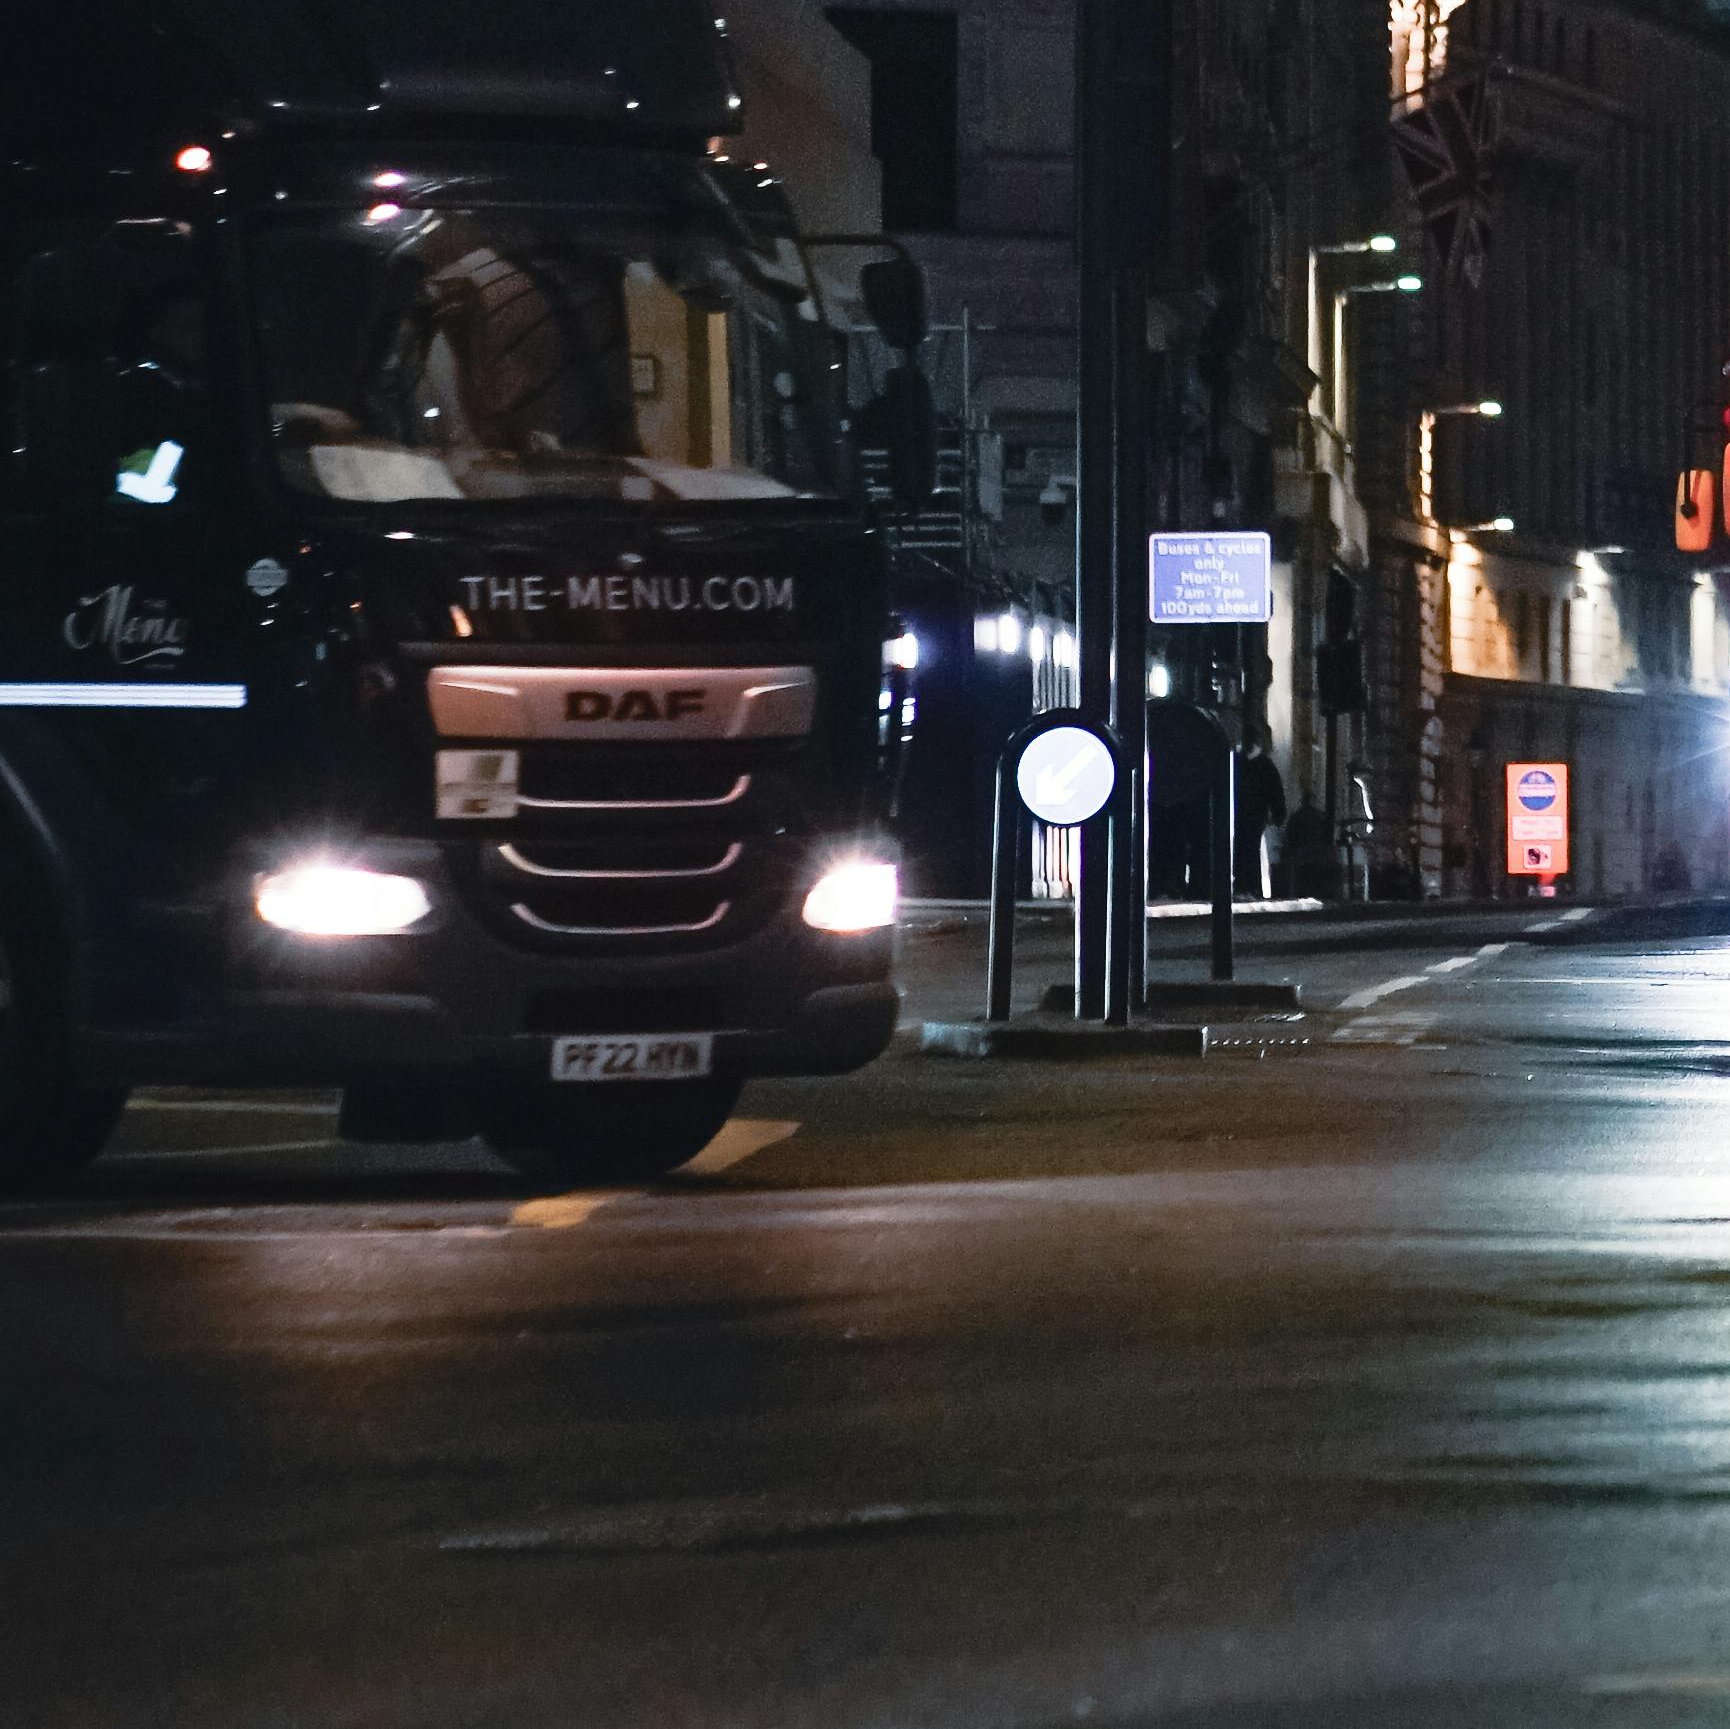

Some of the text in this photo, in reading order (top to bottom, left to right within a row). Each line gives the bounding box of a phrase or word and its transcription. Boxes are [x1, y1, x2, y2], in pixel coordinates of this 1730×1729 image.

[1158, 541, 1200, 555] Buses
[1218, 542, 1261, 557] cycles
[1194, 556, 1224, 572] only
[459, 575, 794, 611] THE-MENU.COM
[1216, 602, 1259, 615] ahead
[564, 692, 705, 722] DAF
